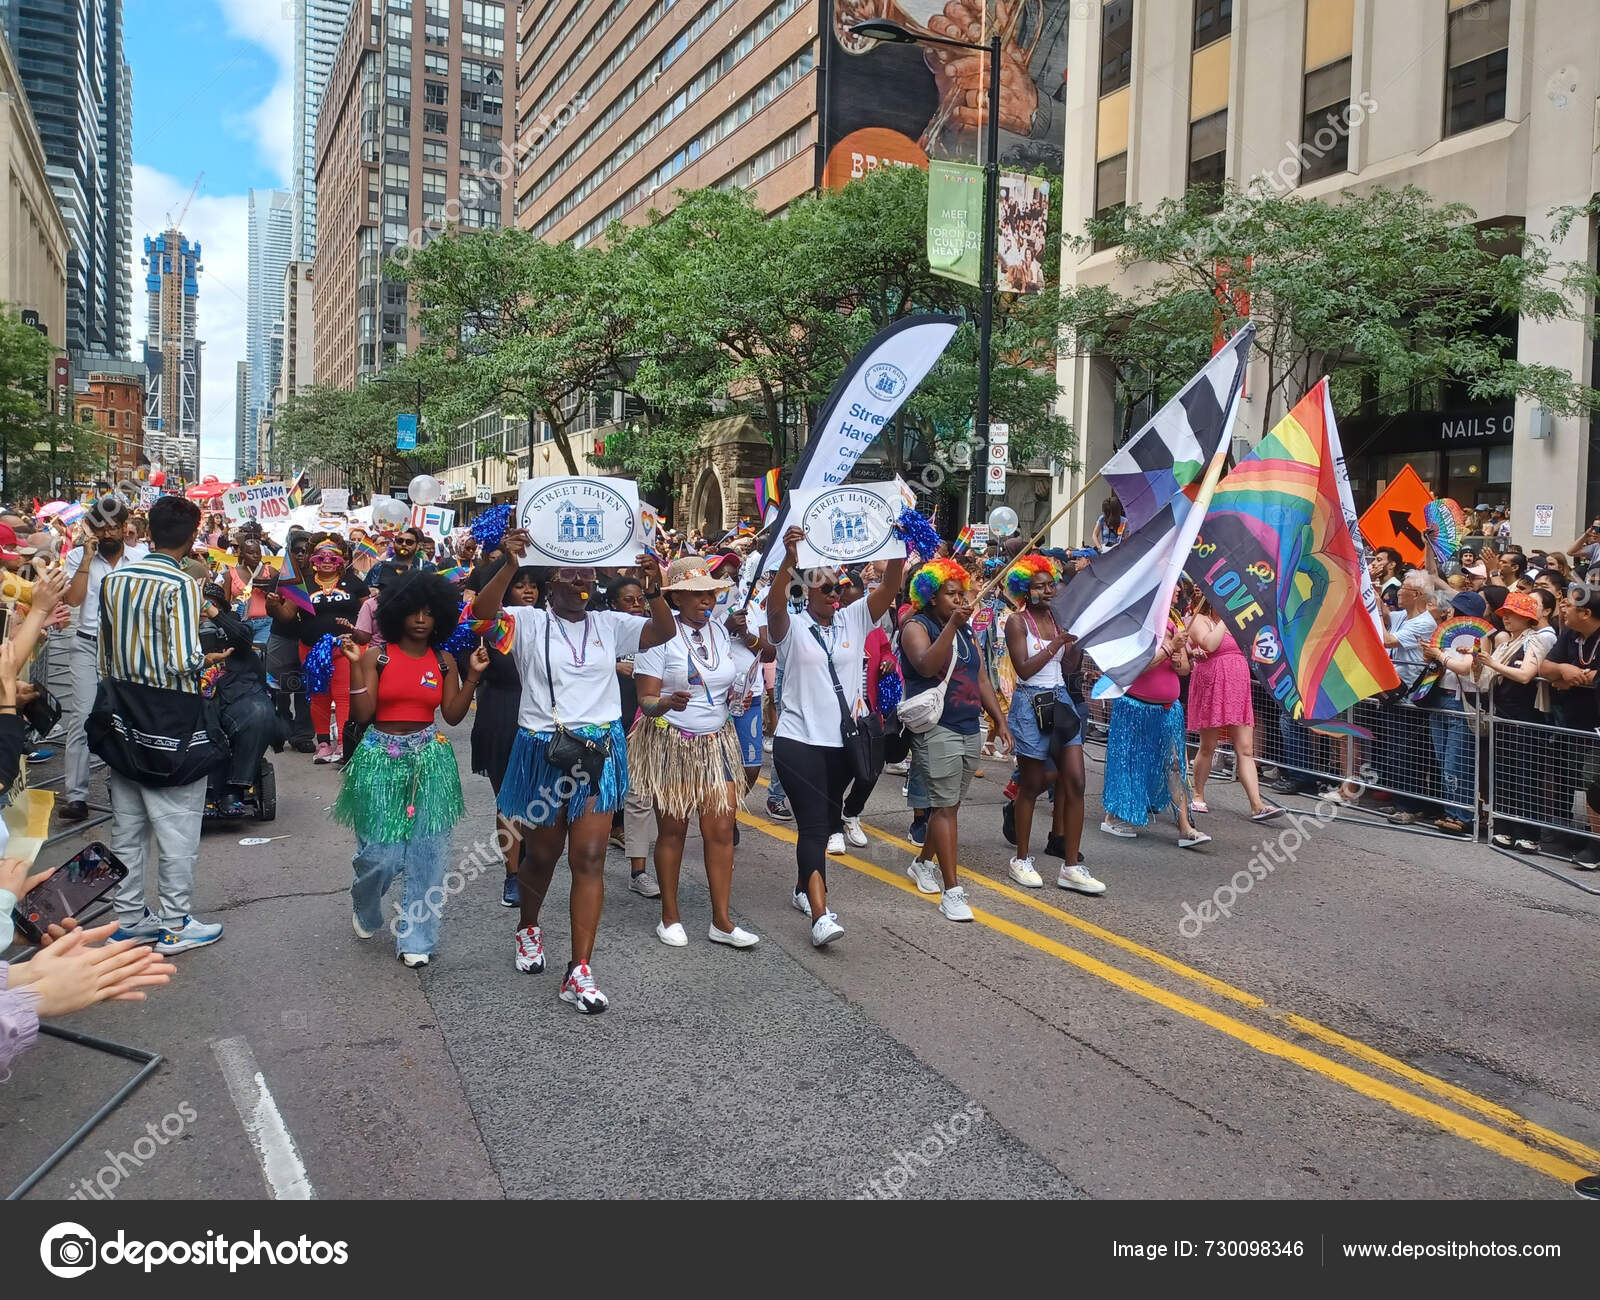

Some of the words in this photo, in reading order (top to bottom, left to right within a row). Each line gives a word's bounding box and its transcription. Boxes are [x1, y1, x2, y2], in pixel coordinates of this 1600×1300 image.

[942, 209, 967, 219] MEET
[1442, 417, 1496, 439] NAILS
[229, 491, 247, 504] END
[246, 486, 284, 501] STIGMA
[477, 491, 490, 500] 40
[533, 486, 578, 512] STREET
[583, 486, 622, 512] HAVEN
[260, 497, 290, 519] AIDS
[811, 494, 845, 520] STREET
[848, 493, 883, 512] HAVEN
[545, 542, 569, 557] caring
[572, 548, 584, 557] for
[586, 542, 614, 556] women
[822, 545, 843, 557] caring
[326, 593, 350, 602] YOU
[1204, 557, 1264, 630] LOVE
[1254, 635, 1274, 659] is
